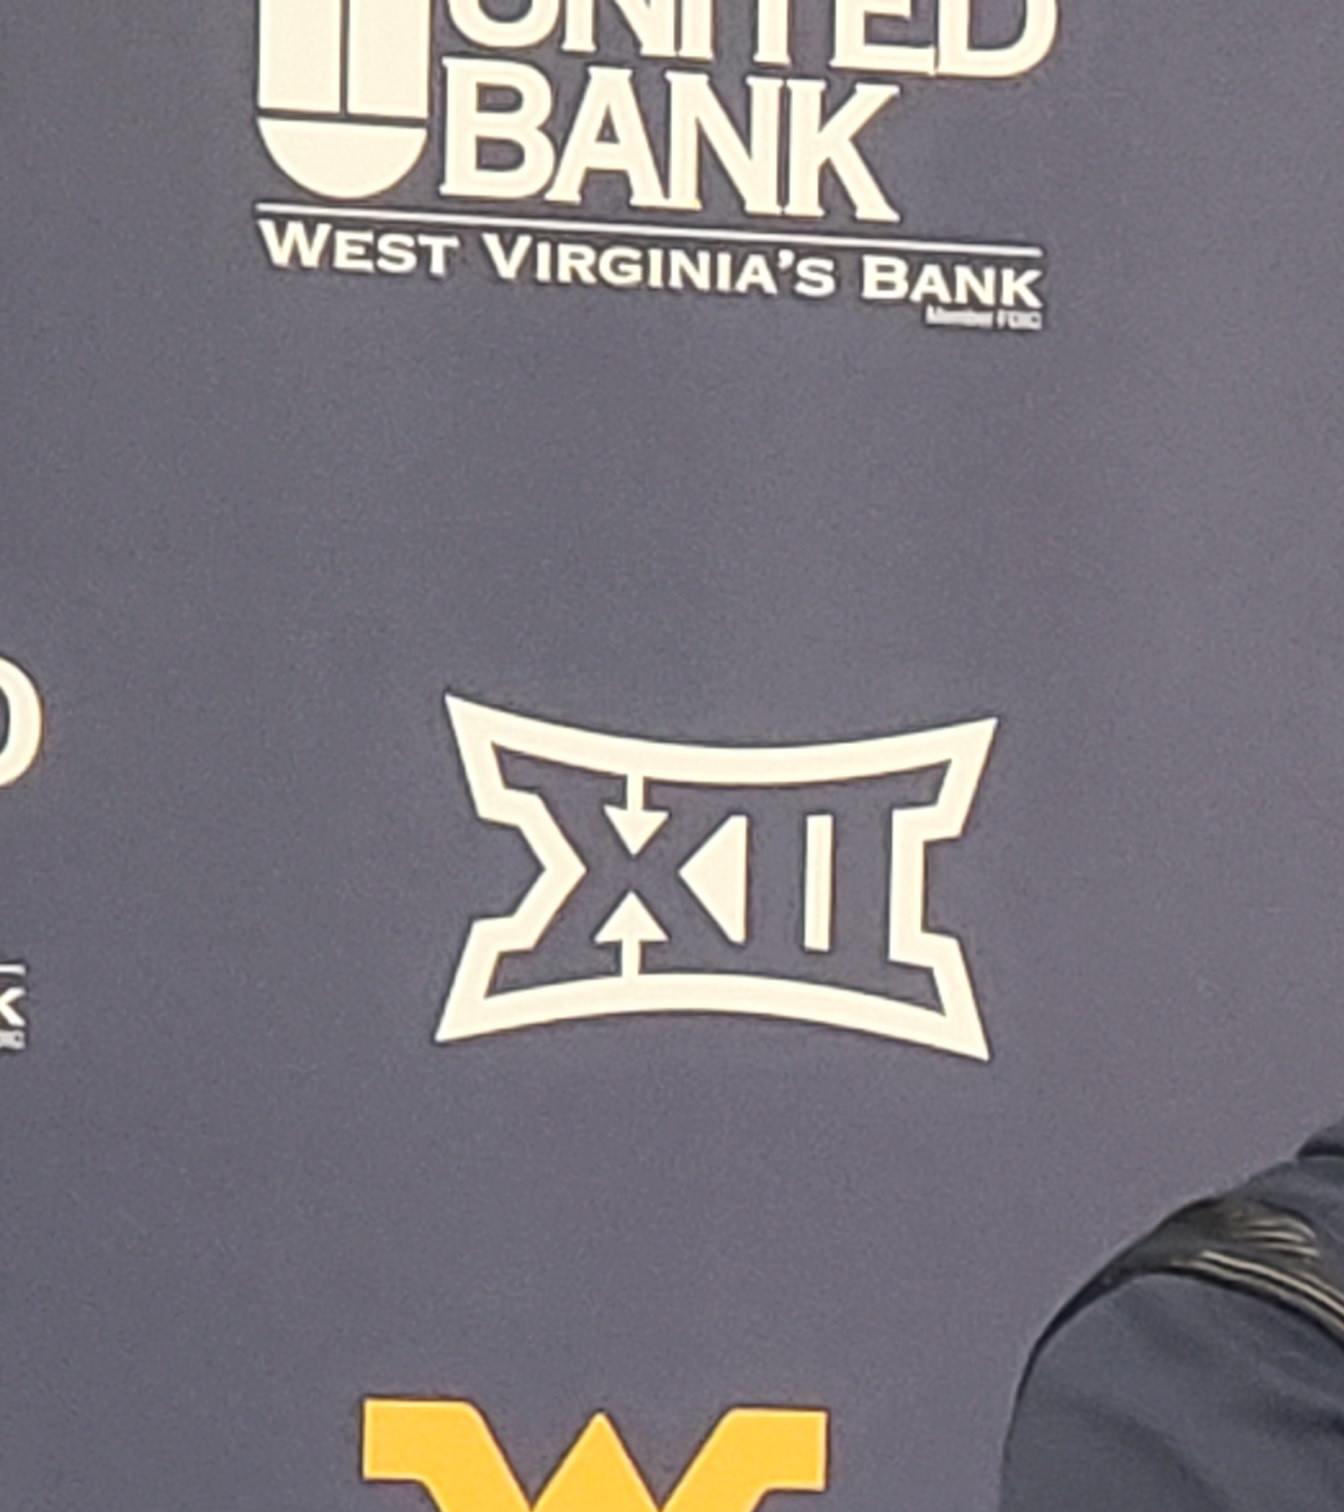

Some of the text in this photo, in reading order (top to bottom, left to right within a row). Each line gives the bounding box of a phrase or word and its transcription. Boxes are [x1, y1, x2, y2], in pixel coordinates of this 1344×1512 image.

[439, 56, 901, 223] BANK
[257, 219, 1042, 309] WEST VIRGINIA'S BANK
